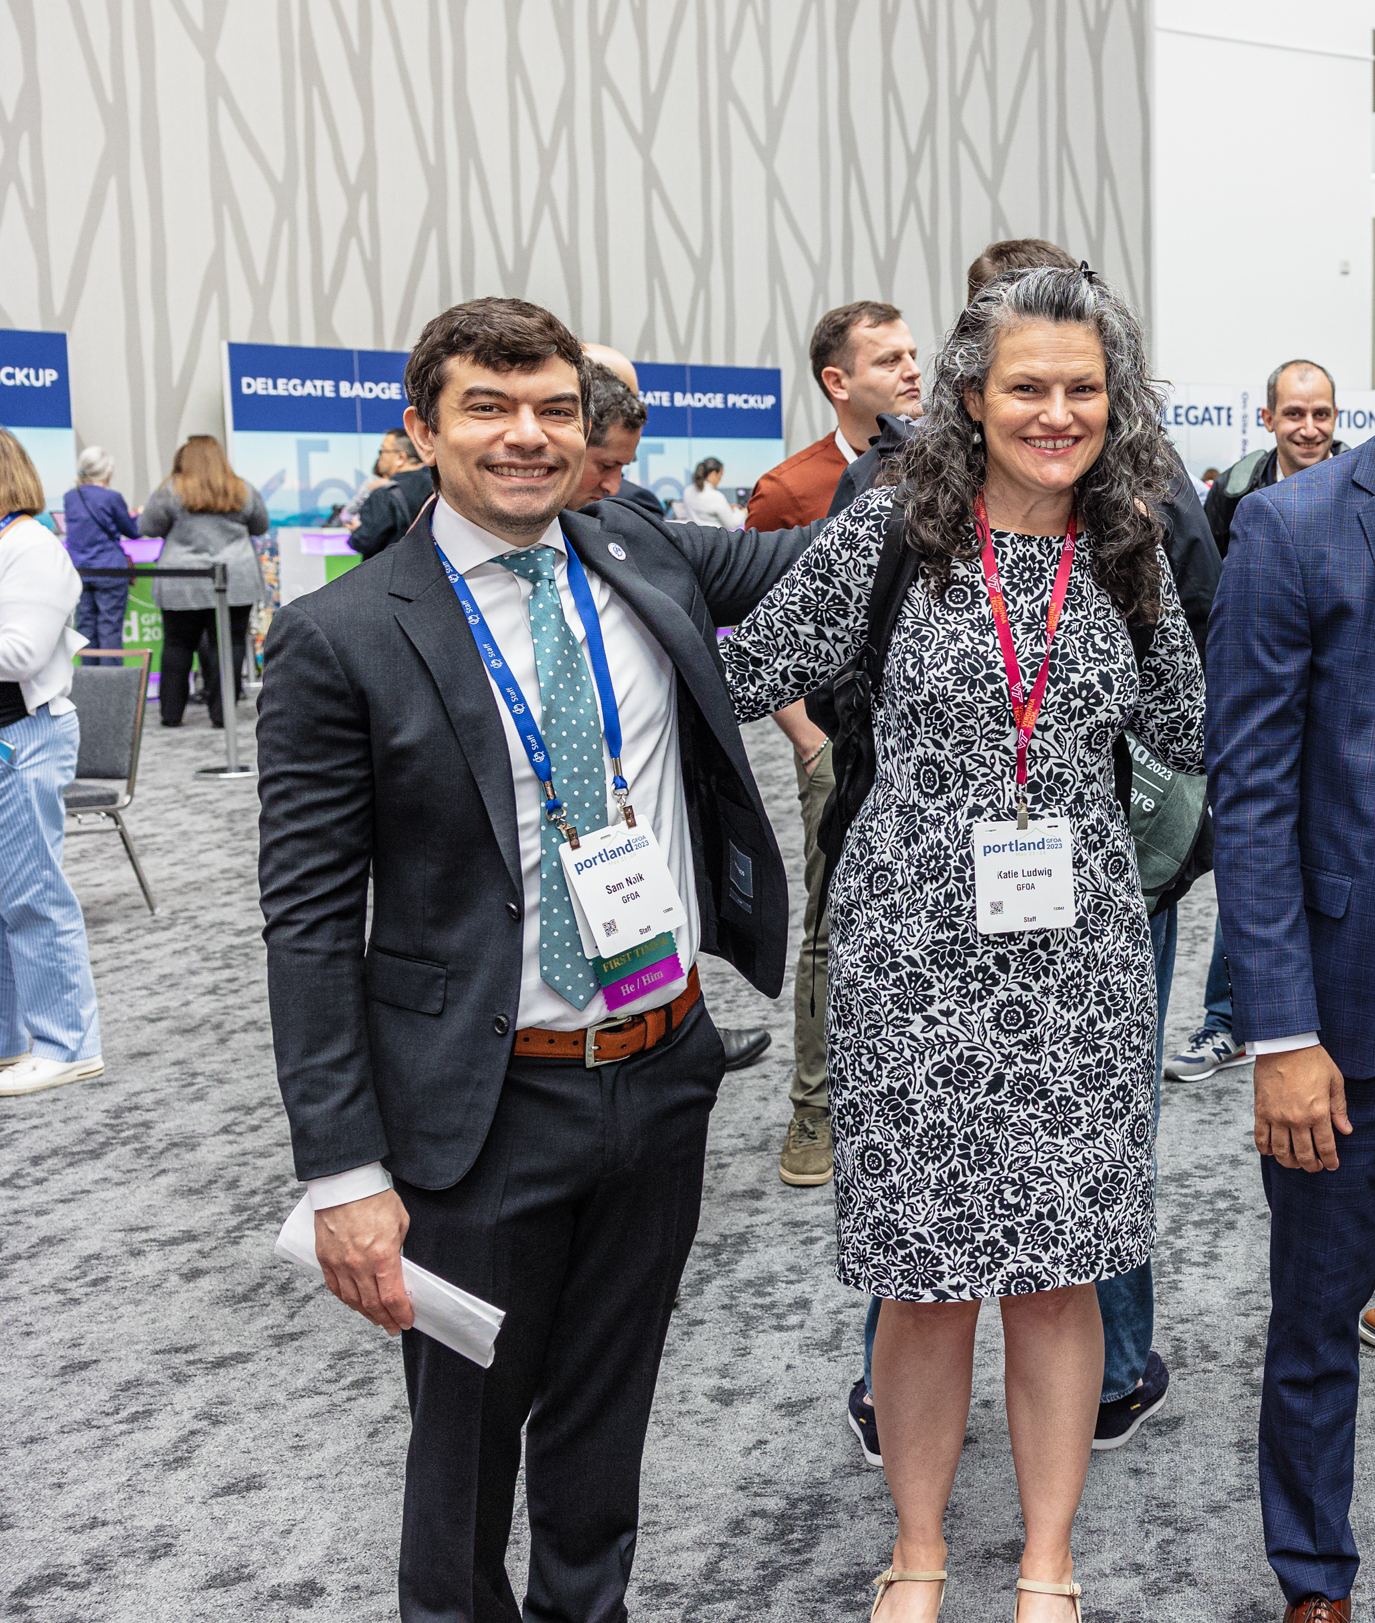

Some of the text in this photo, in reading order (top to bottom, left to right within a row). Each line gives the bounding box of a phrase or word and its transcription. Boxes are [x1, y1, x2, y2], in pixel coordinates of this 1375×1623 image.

[241, 376, 402, 400] DELEGATE BADGE
[673, 391, 725, 408] BADGE
[727, 394, 777, 410] PICKUP
[1021, 698, 1036, 728] VIRGINIA
[1146, 759, 1173, 781] 2023
[574, 839, 634, 875] portland
[983, 837, 1046, 857] portland
[605, 871, 645, 895] Sam Naik
[997, 867, 1053, 880] Katie Ludwig
[621, 891, 641, 904] GFOA
[1016, 883, 1036, 892] GFOA
[638, 925, 652, 936] Staff
[602, 936, 668, 973] FIRST TIMER
[620, 983, 636, 997] He
[641, 970, 664, 986] Him
